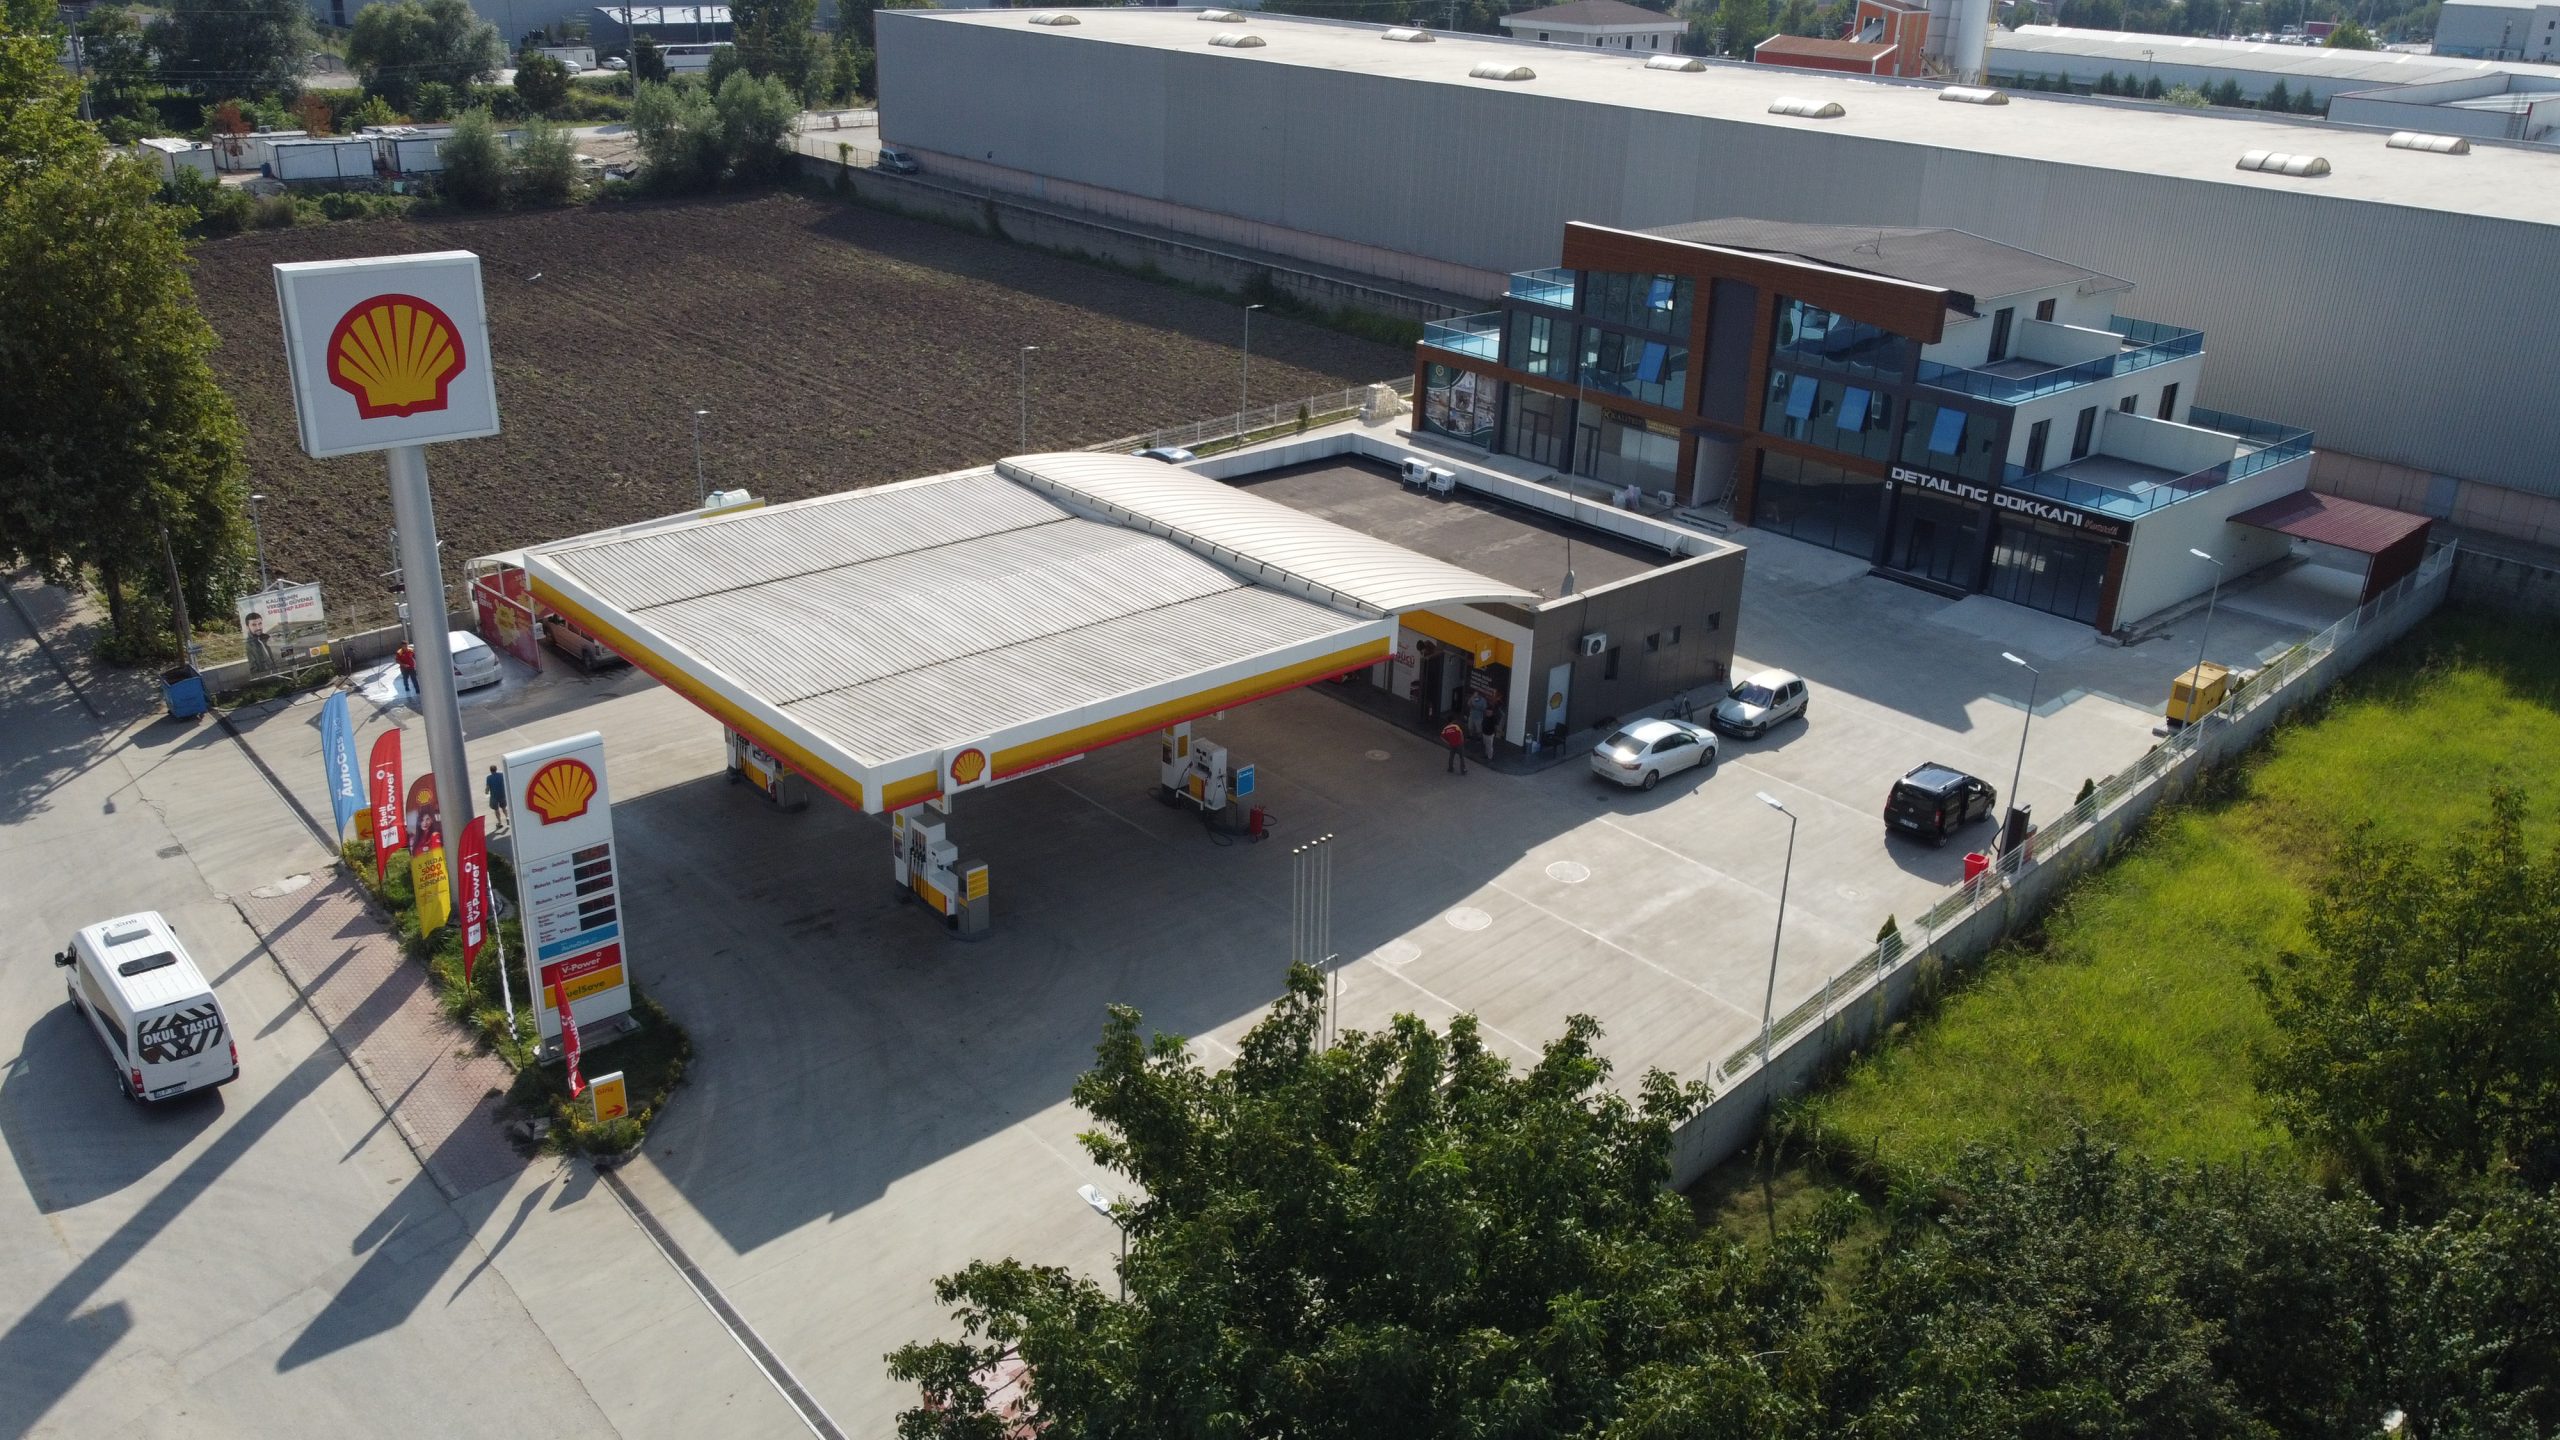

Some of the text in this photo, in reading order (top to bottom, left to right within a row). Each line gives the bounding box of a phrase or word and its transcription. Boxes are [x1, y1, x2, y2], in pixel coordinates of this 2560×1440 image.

[1891, 467, 1989, 502] DETAILING
[336, 736, 355, 797] AutoGas
[386, 772, 397, 824] V-Power
[379, 806, 388, 827] Shell
[472, 864, 481, 920] V-Power
[561, 957, 601, 974] V-Power
[567, 980, 606, 998] uelSave
[143, 1028, 177, 1046] OKUL
